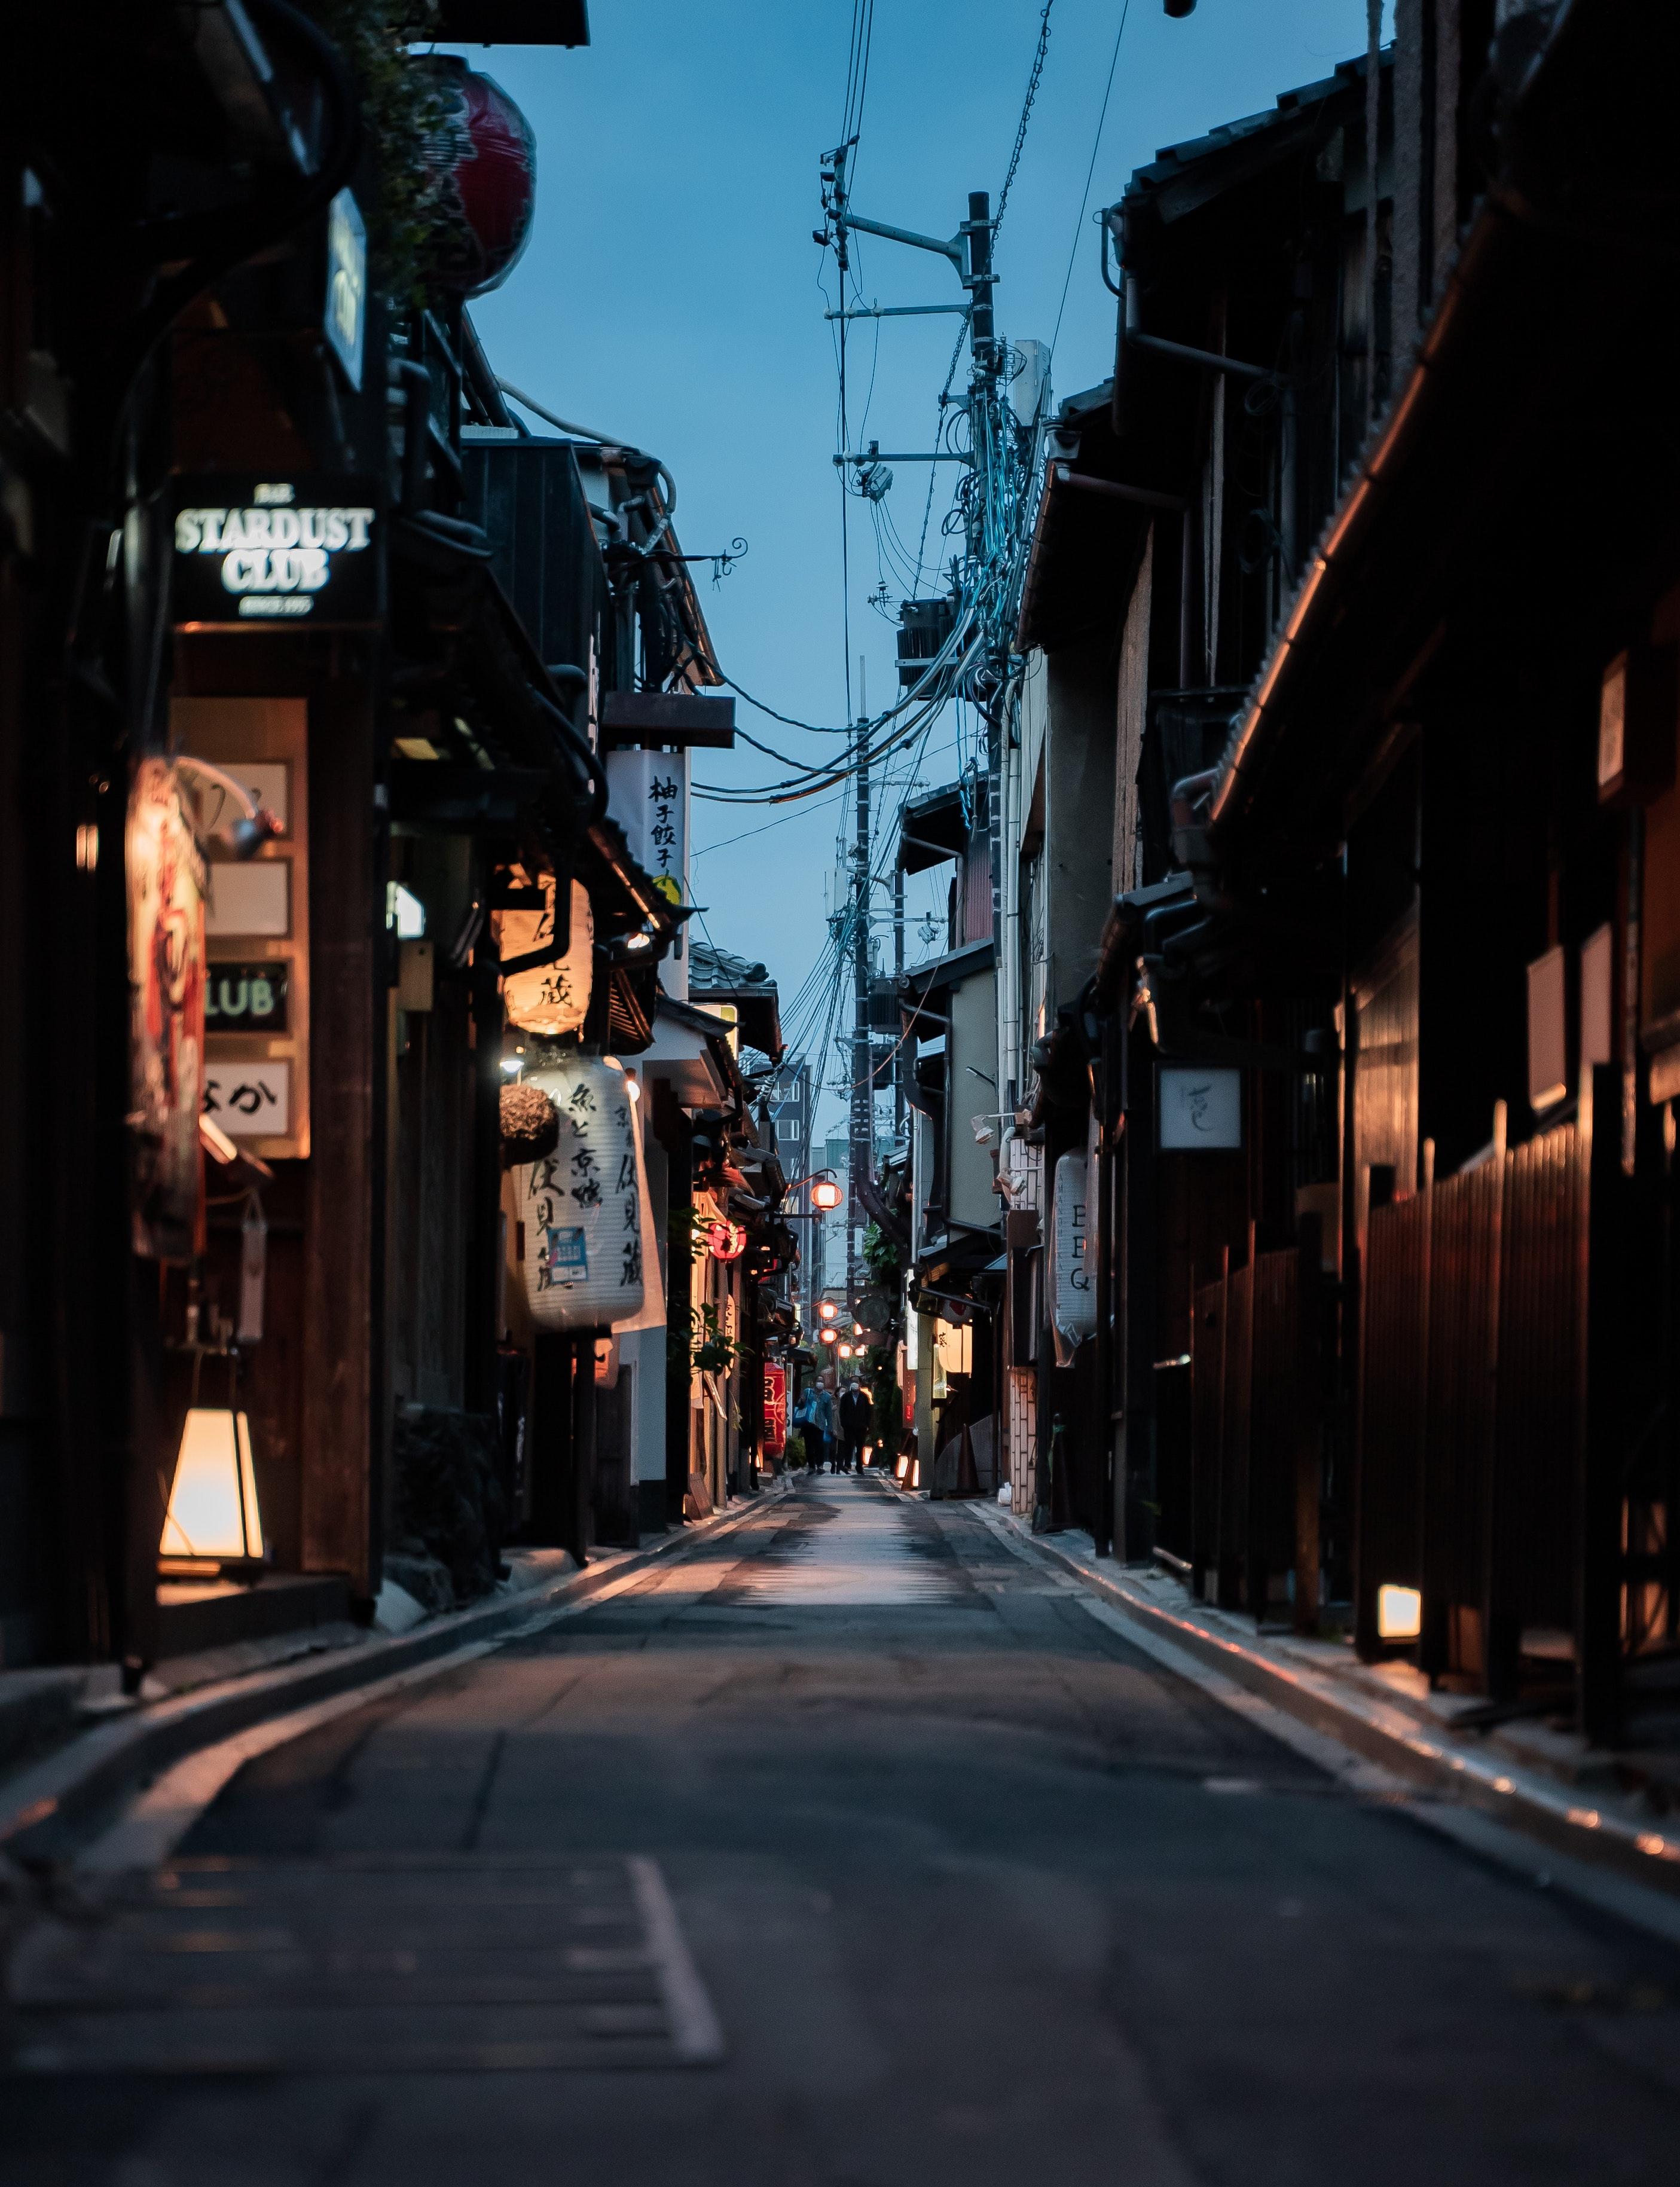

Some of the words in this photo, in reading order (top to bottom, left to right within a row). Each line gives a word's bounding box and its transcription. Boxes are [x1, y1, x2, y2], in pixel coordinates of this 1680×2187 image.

[176, 508, 375, 552] STARDUST
[222, 548, 330, 592] CLUB
[647, 775, 679, 868] 柚子餃子
[204, 978, 274, 1016] LUB
